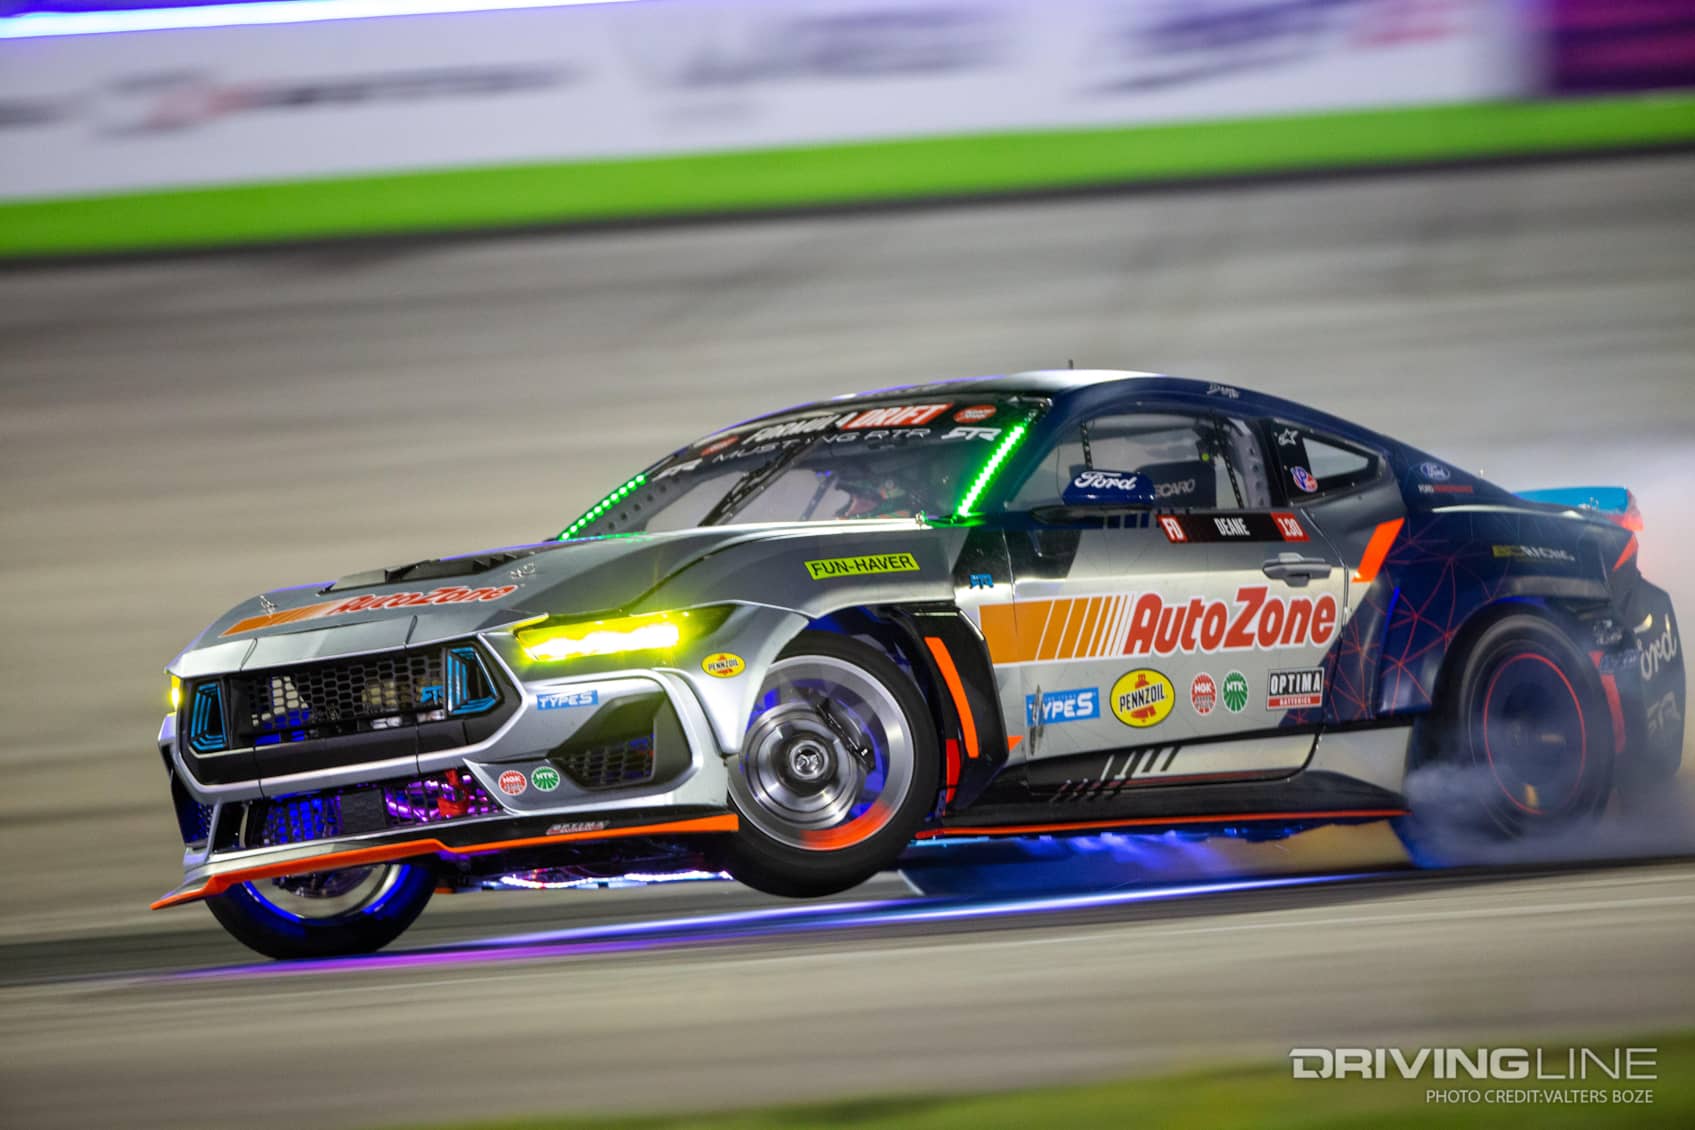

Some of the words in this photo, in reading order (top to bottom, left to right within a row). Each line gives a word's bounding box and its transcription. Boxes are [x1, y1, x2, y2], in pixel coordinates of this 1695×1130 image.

[1074, 471, 1138, 490] Ford
[1154, 479, 1196, 498] ECARO
[1161, 518, 1184, 540] FD
[1214, 518, 1250, 536] DEANE
[1277, 518, 1303, 537] 130
[810, 555, 914, 577] FUN-HAVER
[1122, 585, 1337, 655] AutoZone
[1270, 672, 1321, 695] OPTIMA
[1119, 682, 1166, 713] PENNZOIL
